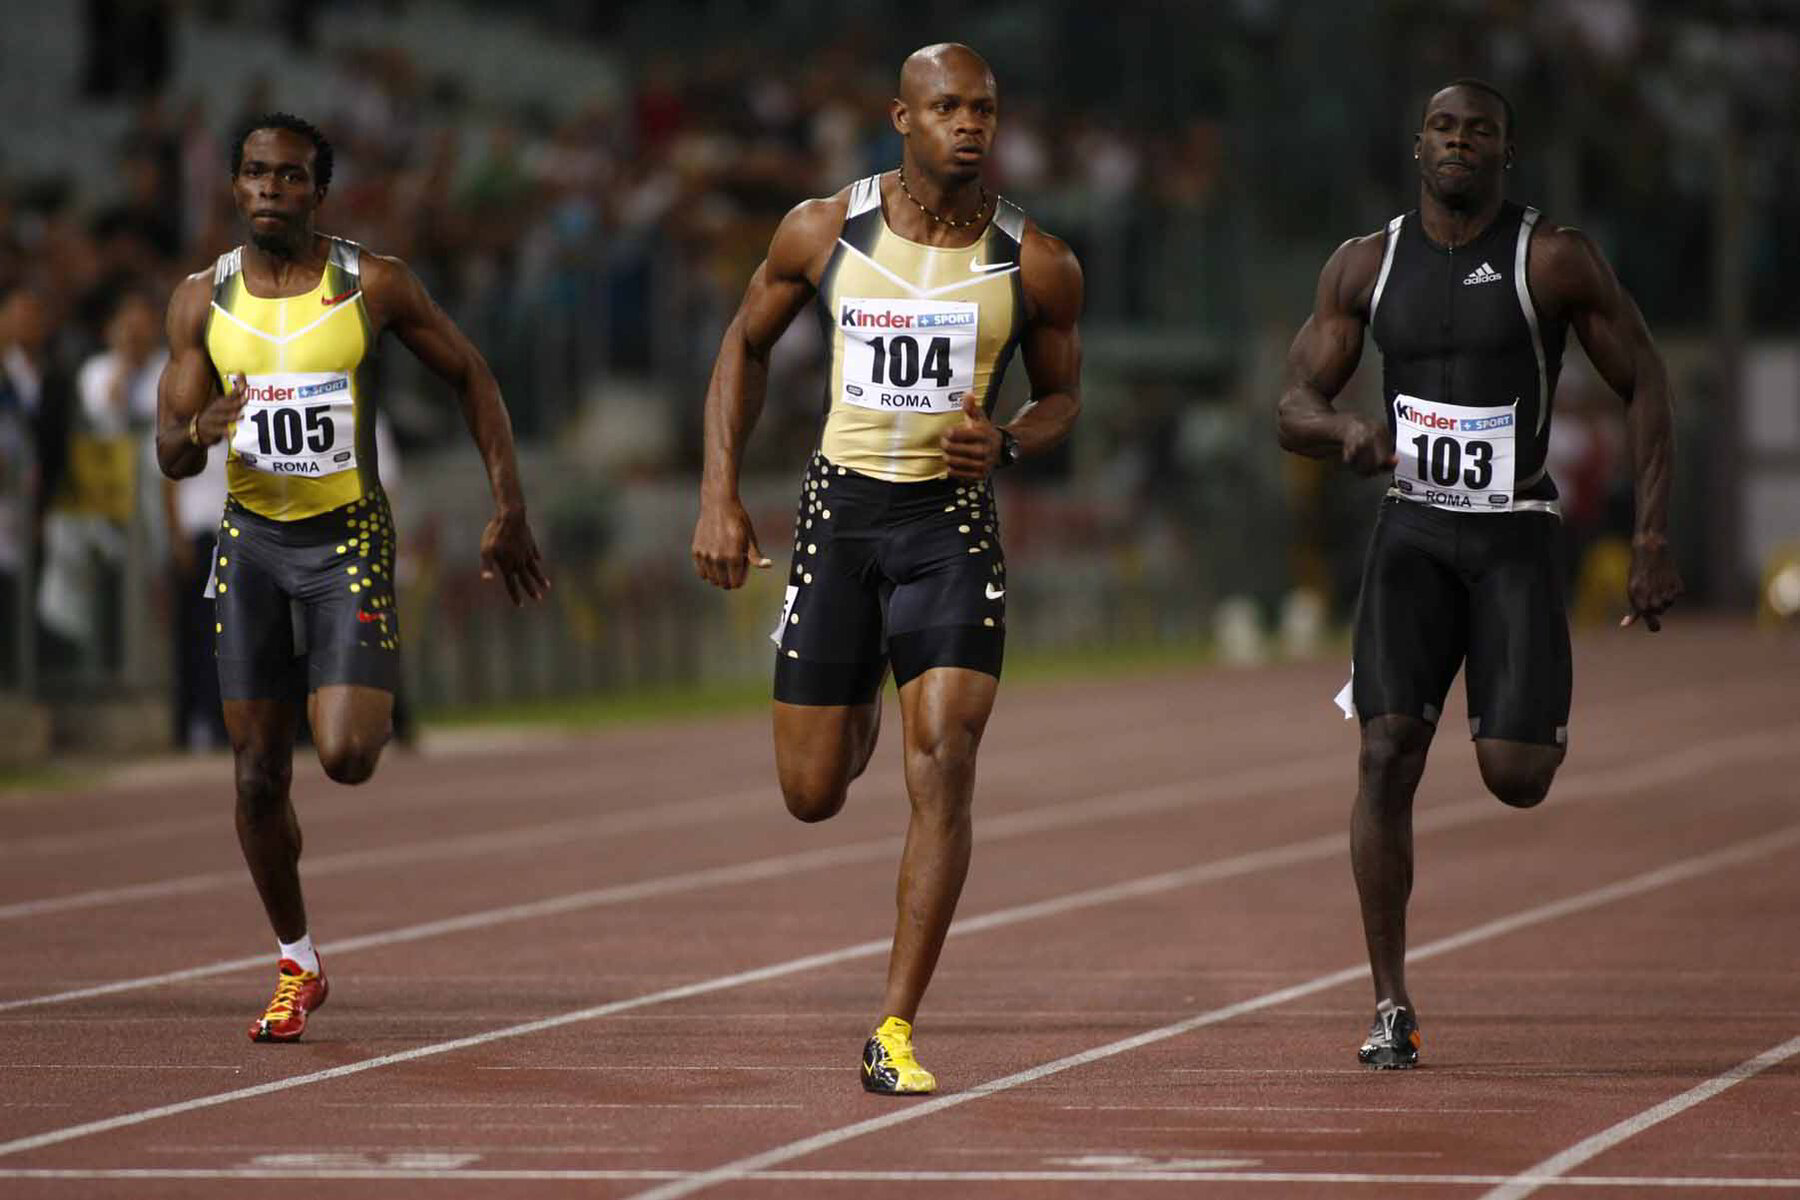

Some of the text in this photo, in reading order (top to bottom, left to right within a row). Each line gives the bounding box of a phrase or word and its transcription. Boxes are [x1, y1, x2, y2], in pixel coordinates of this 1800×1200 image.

[1463, 273, 1502, 285] adidas
[841, 305, 914, 328] Kinder
[933, 313, 972, 325] SPORT
[865, 335, 953, 388] 104
[233, 380, 295, 401] inder
[880, 393, 932, 408] ROMA
[1397, 400, 1457, 430] Kinder
[1476, 416, 1510, 430] SPORT
[250, 404, 335, 456] 105
[272, 461, 320, 473] ROMA
[1412, 433, 1493, 490] 103
[1426, 490, 1472, 508] ROMA
